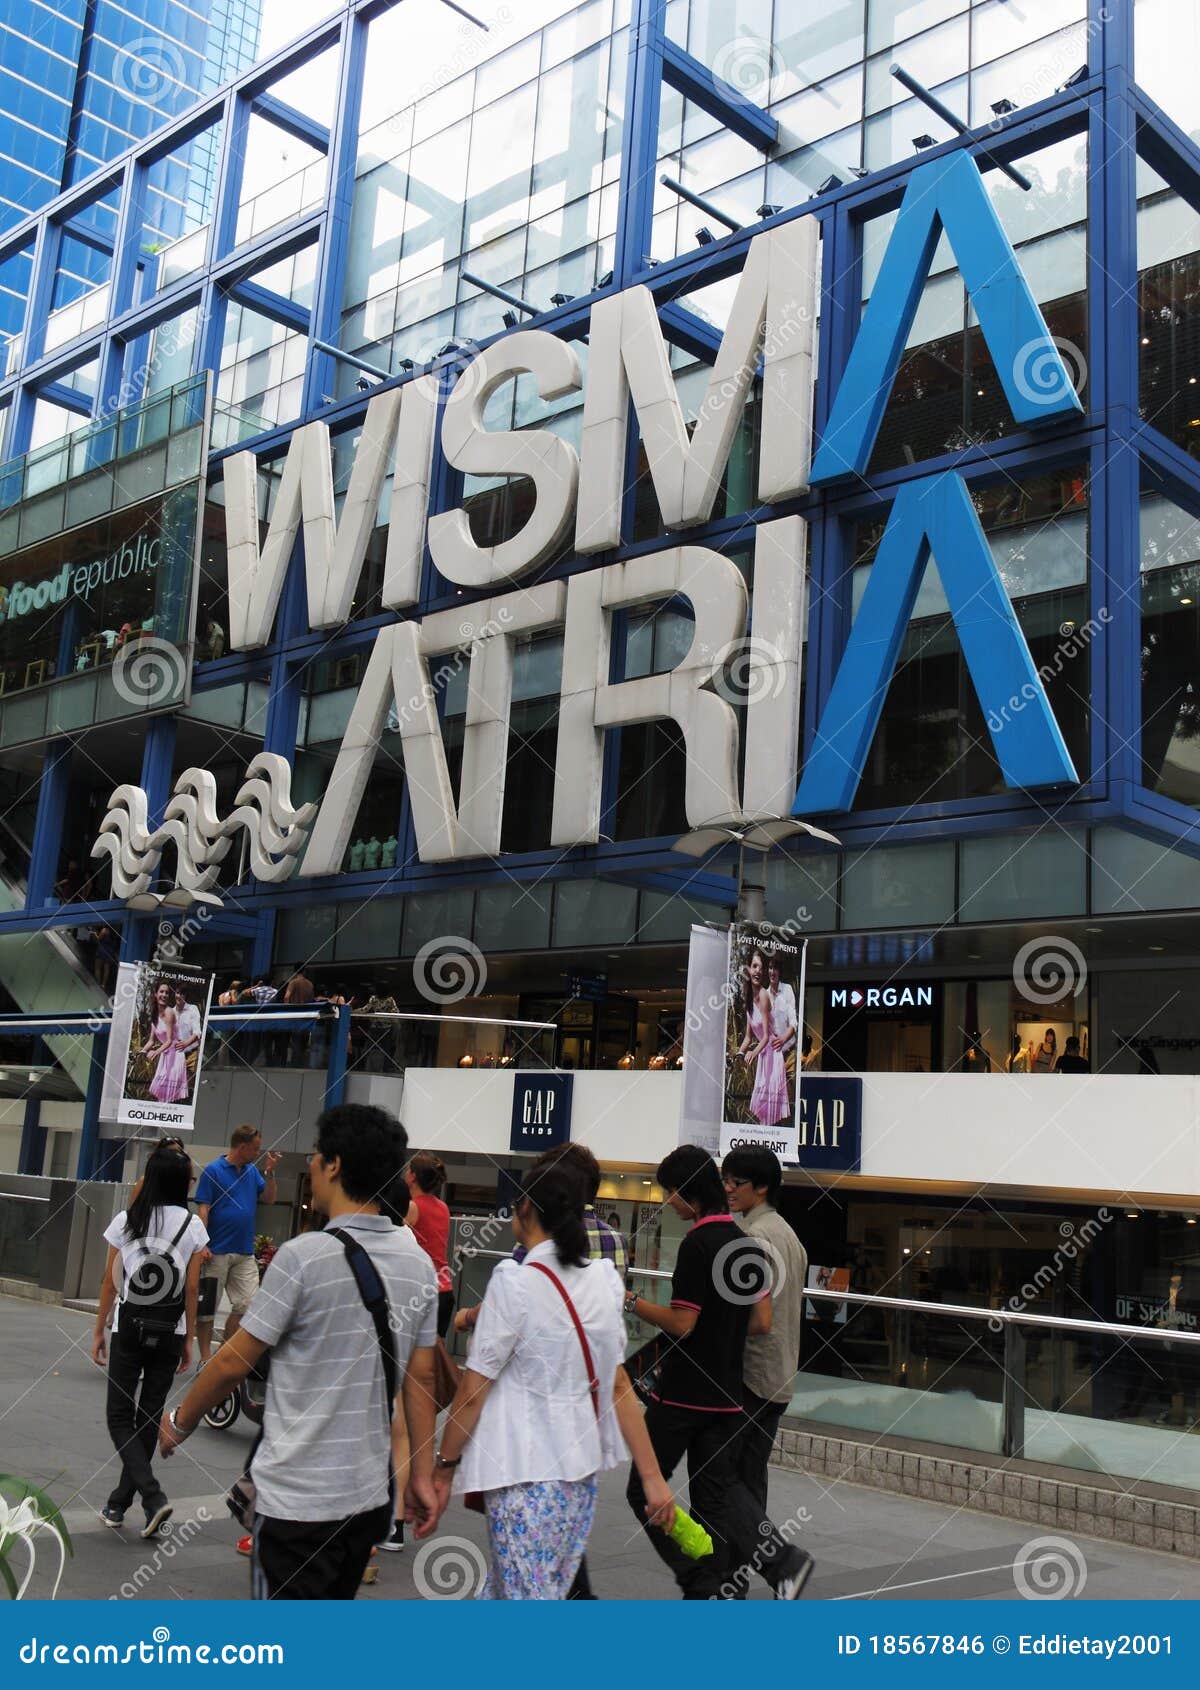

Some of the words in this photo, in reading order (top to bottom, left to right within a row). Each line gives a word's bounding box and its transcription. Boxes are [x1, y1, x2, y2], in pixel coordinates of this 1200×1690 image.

[223, 149, 1083, 651] WISMA
[299, 471, 1081, 877] ATRIA
[736, 932, 752, 944] LOVE
[770, 940, 798, 954] MOMENTS
[178, 973, 206, 984] MOMENTS
[128, 1109, 184, 1124] GOLDHEART
[523, 1089, 555, 1124] GAP
[522, 1127, 552, 1135] KIDS
[798, 1098, 845, 1147] GAP
[1115, 1298, 1135, 1319] OF
[1139, 1303, 1197, 1327] SPRNG
